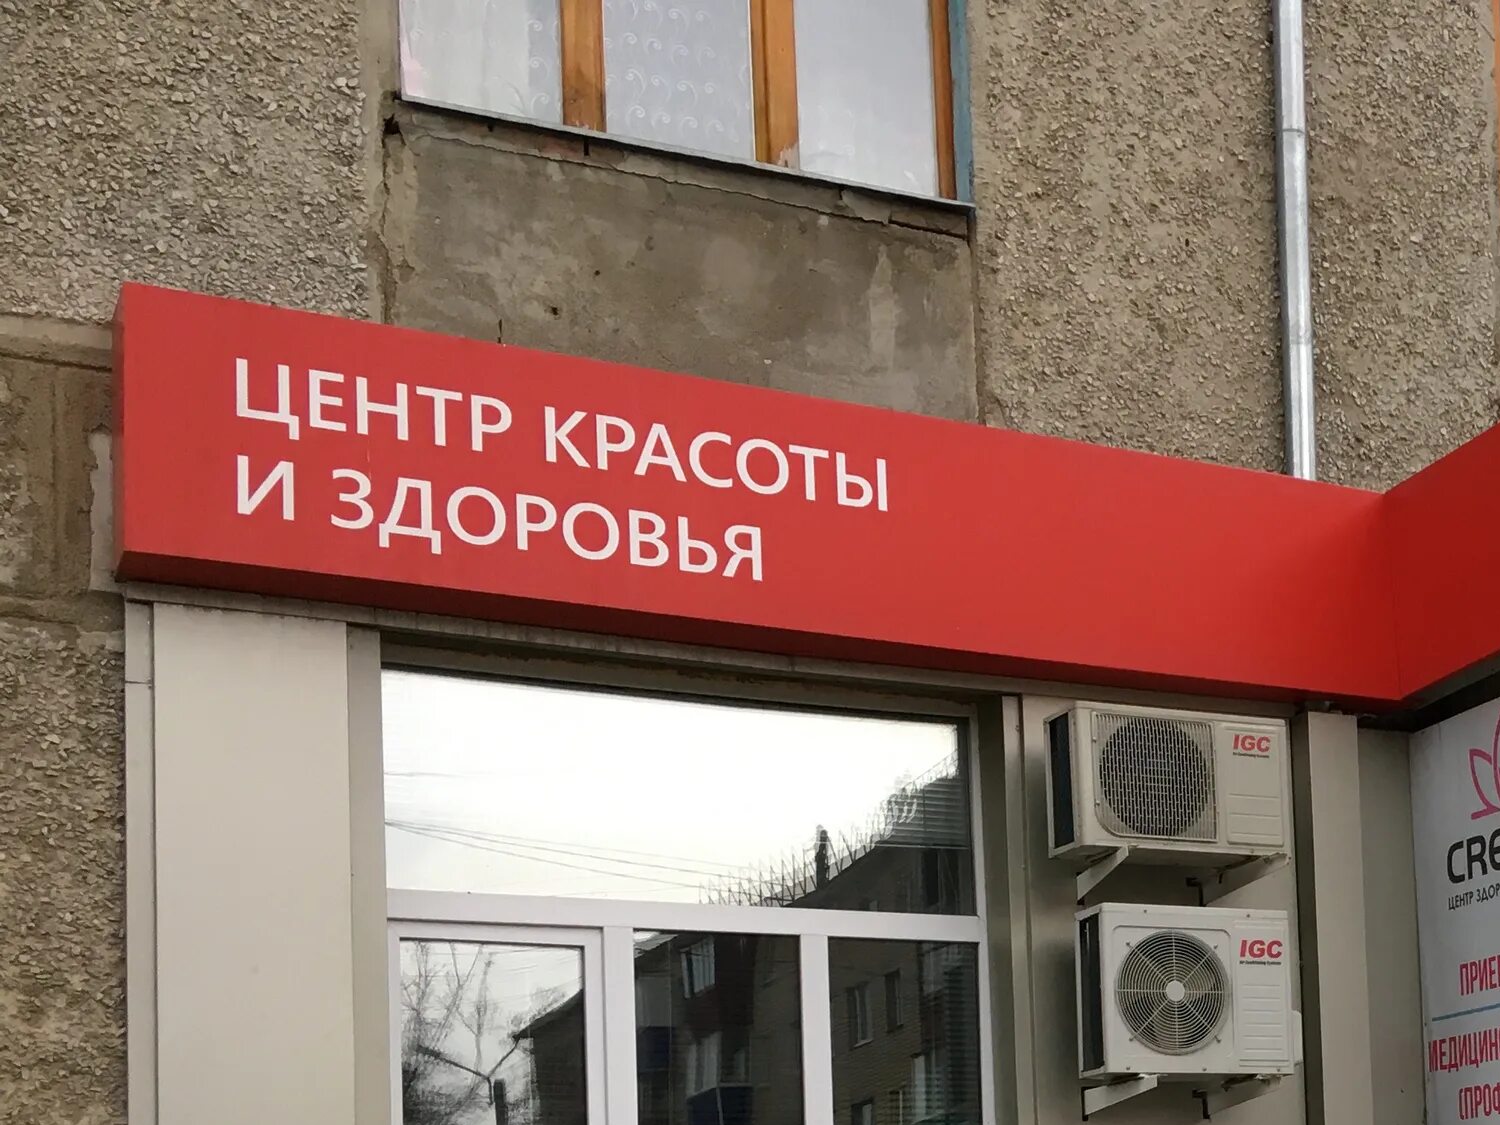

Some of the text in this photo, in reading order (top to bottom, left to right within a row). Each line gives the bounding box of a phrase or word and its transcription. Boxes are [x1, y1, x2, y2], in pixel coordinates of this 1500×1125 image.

[235, 357, 889, 512] ЦЕНТР КРАСОТЫ
[236, 455, 764, 582] И ЗДОРОВЬЯ
[1232, 733, 1271, 753] IGC
[1448, 890, 1474, 911] ЦЕНТР
[1240, 939, 1283, 958] IGC
